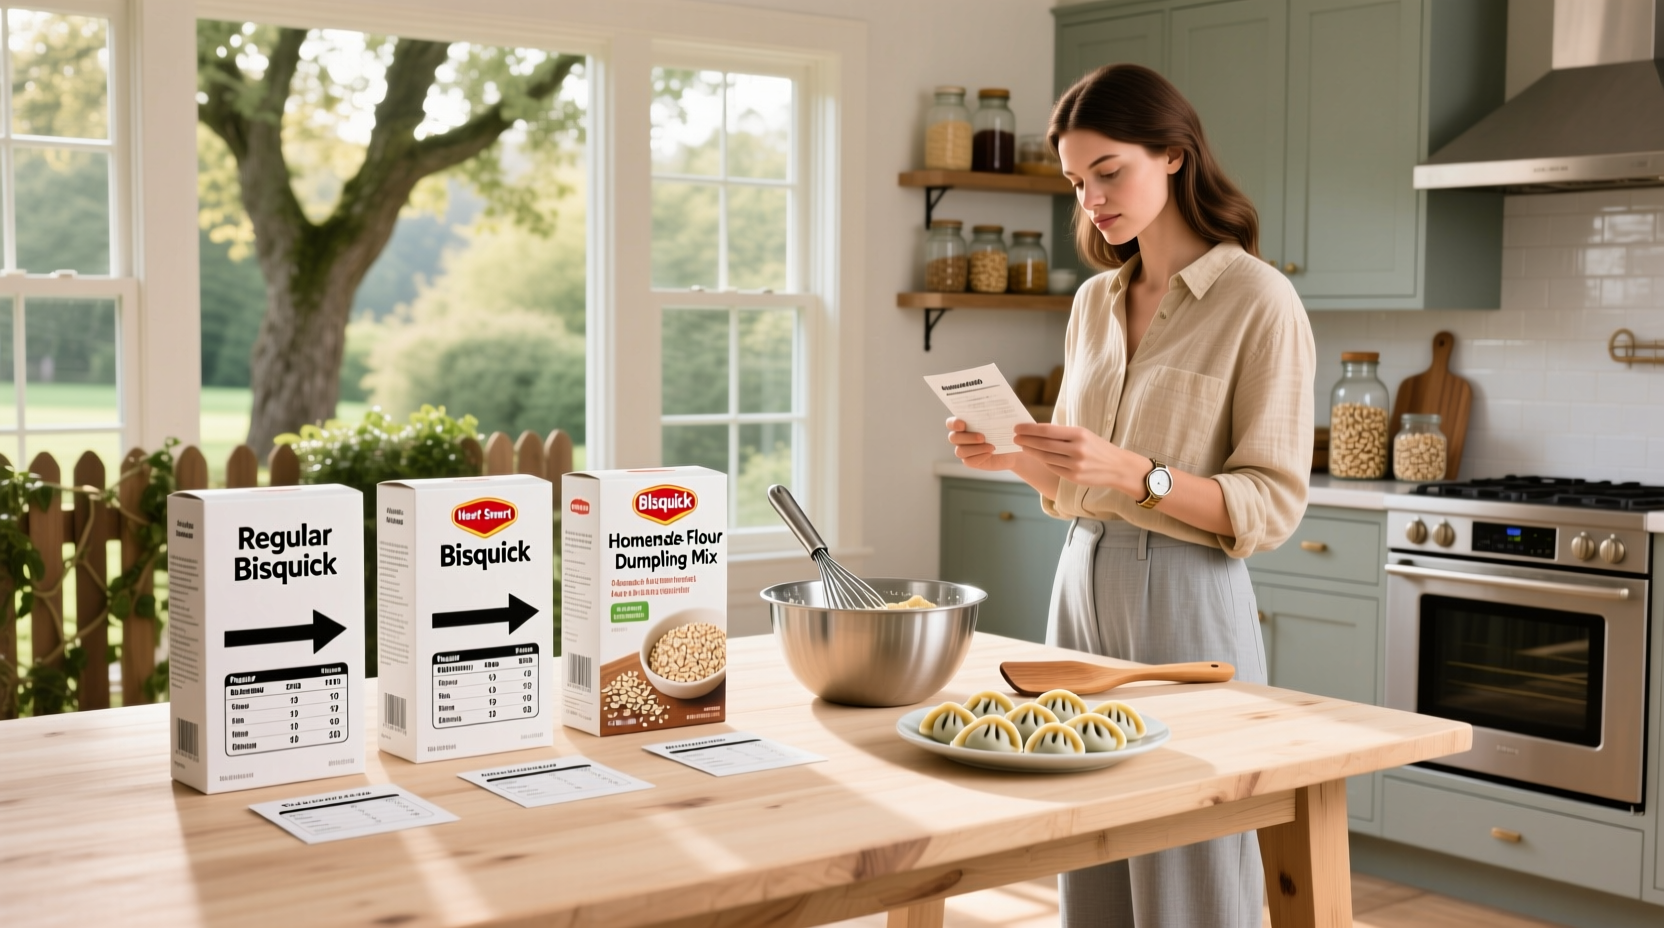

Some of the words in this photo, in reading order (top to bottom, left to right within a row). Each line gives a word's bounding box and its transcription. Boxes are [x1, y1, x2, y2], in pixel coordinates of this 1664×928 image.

[238, 522, 333, 555] Regular
[686, 528, 723, 546] Flour
[234, 551, 338, 585] Bisquick
[440, 540, 531, 571] Bisquick
[615, 549, 688, 573] Dumpling
[691, 548, 718, 565] Mix
